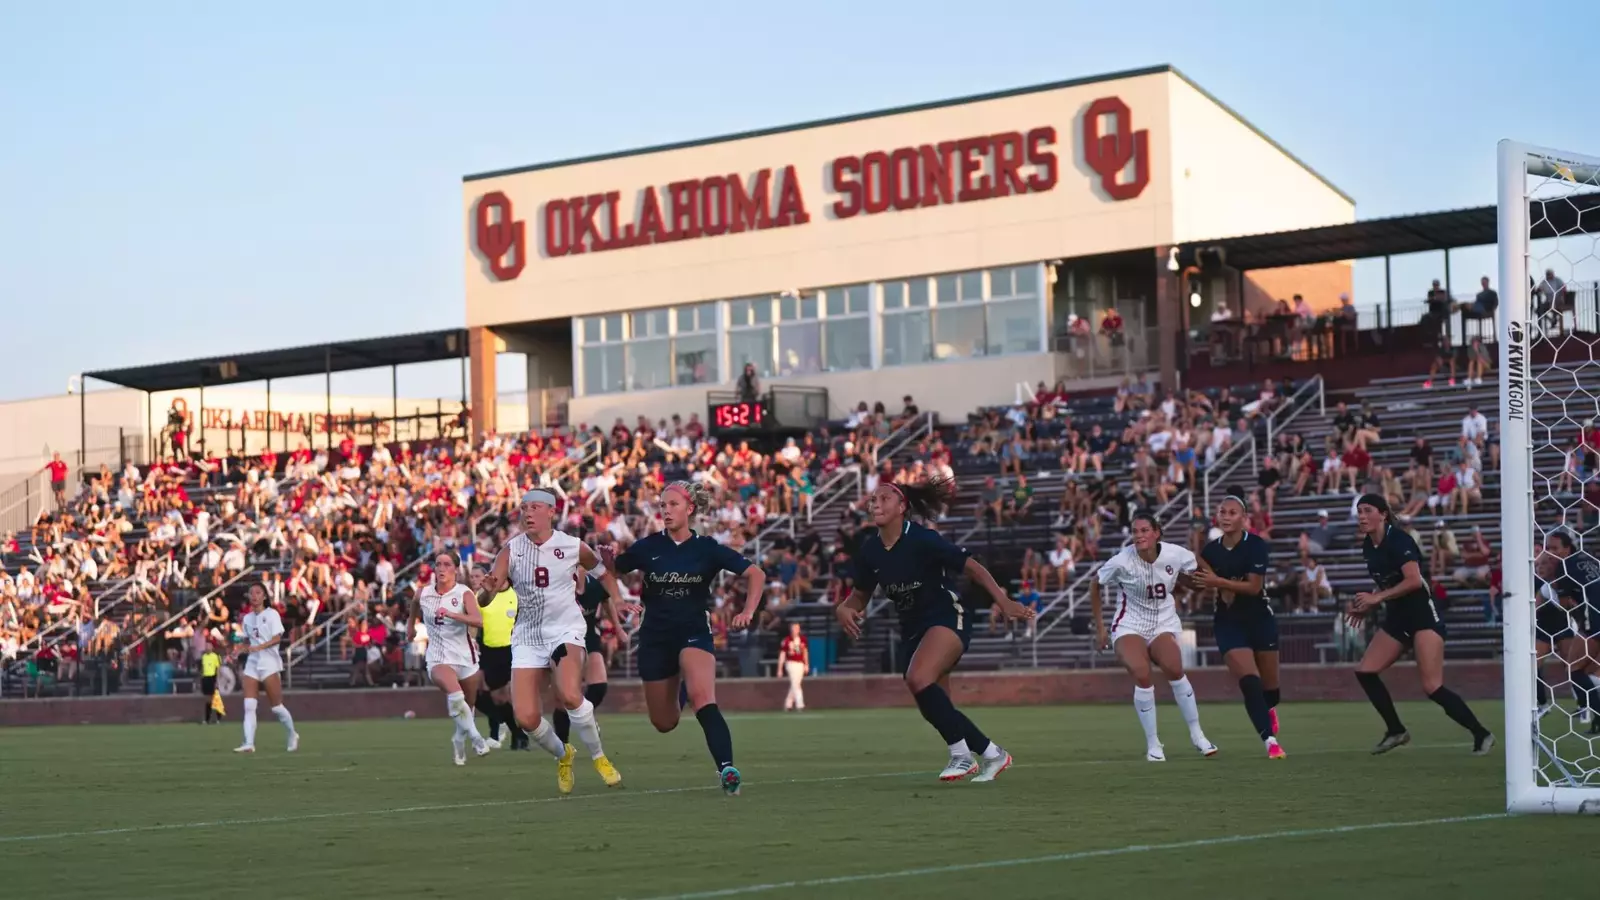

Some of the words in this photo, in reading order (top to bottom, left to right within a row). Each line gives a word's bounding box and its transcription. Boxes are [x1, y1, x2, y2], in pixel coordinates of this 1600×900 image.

[476, 190, 526, 281] OU
[544, 163, 811, 258] OKLAHOMA
[831, 125, 1059, 220] SOONERS
[1083, 95, 1150, 201] OU
[715, 402, 762, 427] 15:21
[535, 566, 550, 588] 8
[649, 571, 668, 583] Oral
[668, 571, 703, 583] Roberts
[1146, 582, 1167, 599] 19
